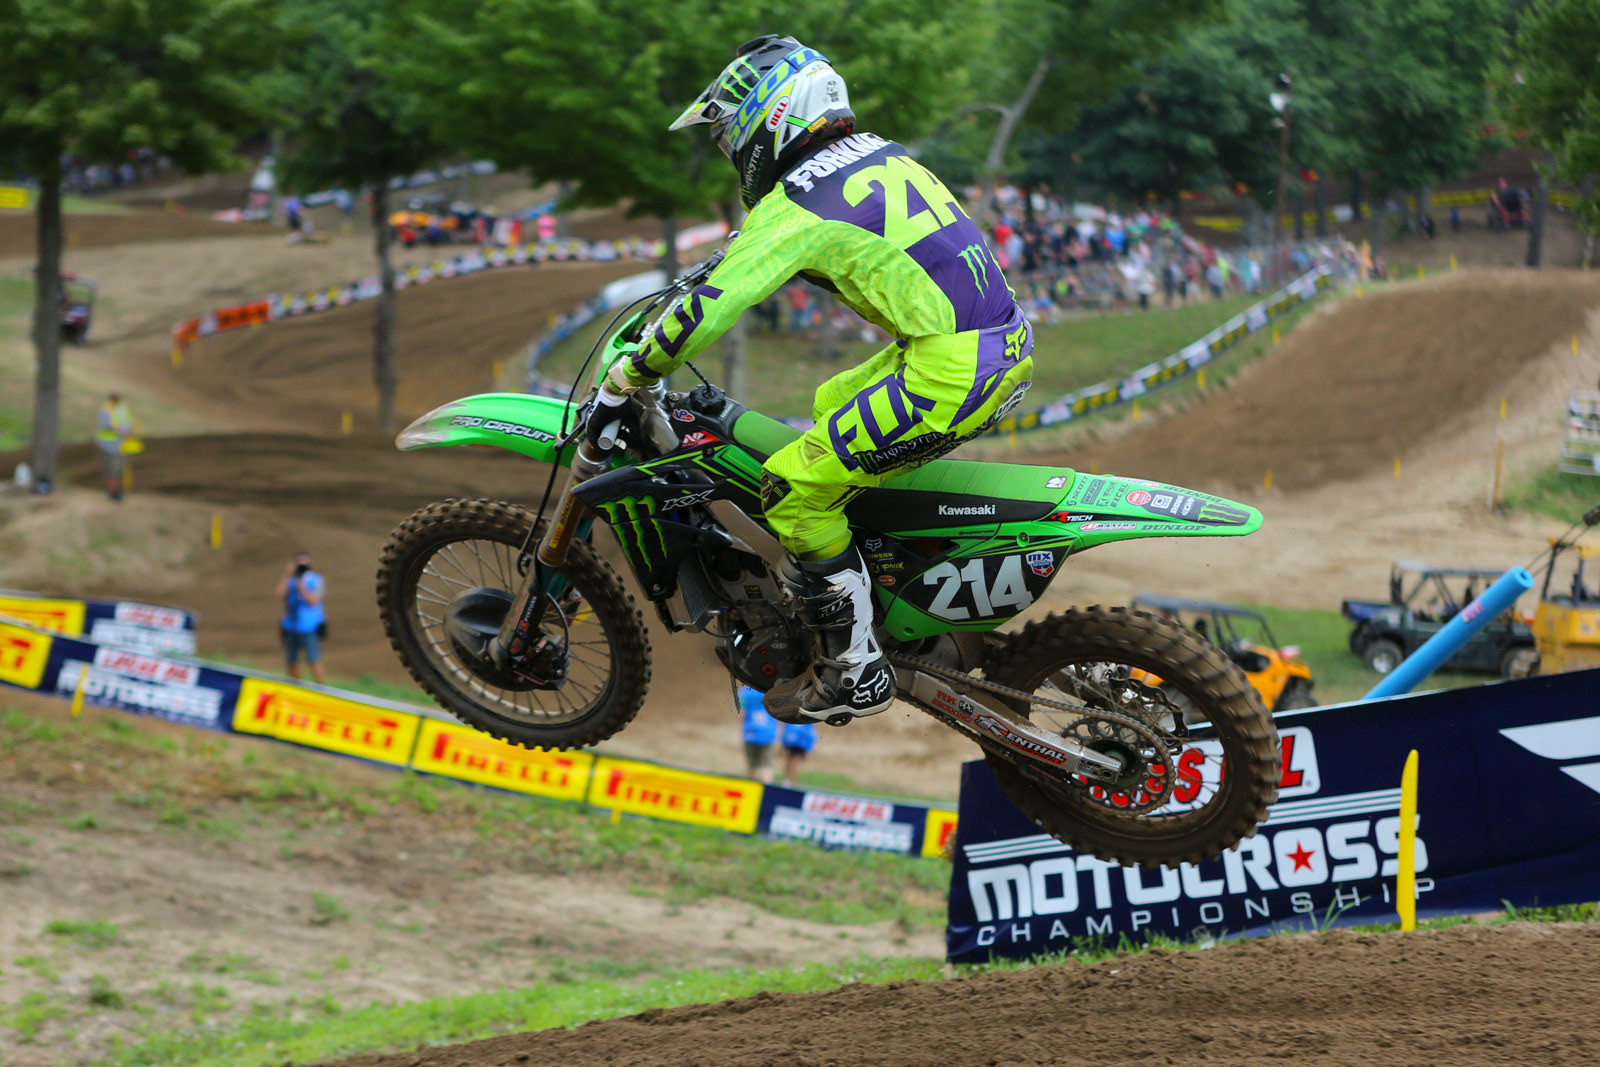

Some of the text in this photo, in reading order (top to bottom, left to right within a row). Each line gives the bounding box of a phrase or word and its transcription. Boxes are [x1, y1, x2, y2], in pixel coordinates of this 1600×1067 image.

[769, 102, 788, 126] BELL
[631, 285, 724, 378] FOX
[451, 415, 556, 442] PRO CIRCUIT
[828, 363, 937, 472] FOX
[875, 431, 944, 462] MONSTER
[662, 489, 715, 511] KX
[1072, 476, 1088, 499] SCOTT
[1111, 484, 1128, 507] EXCEL
[939, 504, 996, 516] Kawasaki
[924, 554, 1034, 620] 214
[937, 690, 957, 705] RK
[255, 692, 398, 748] PIRELLI
[433, 733, 573, 788] PIRELLI
[607, 770, 743, 818] PIRELLI
[977, 878, 1435, 947] CHAMPIONSHIP
